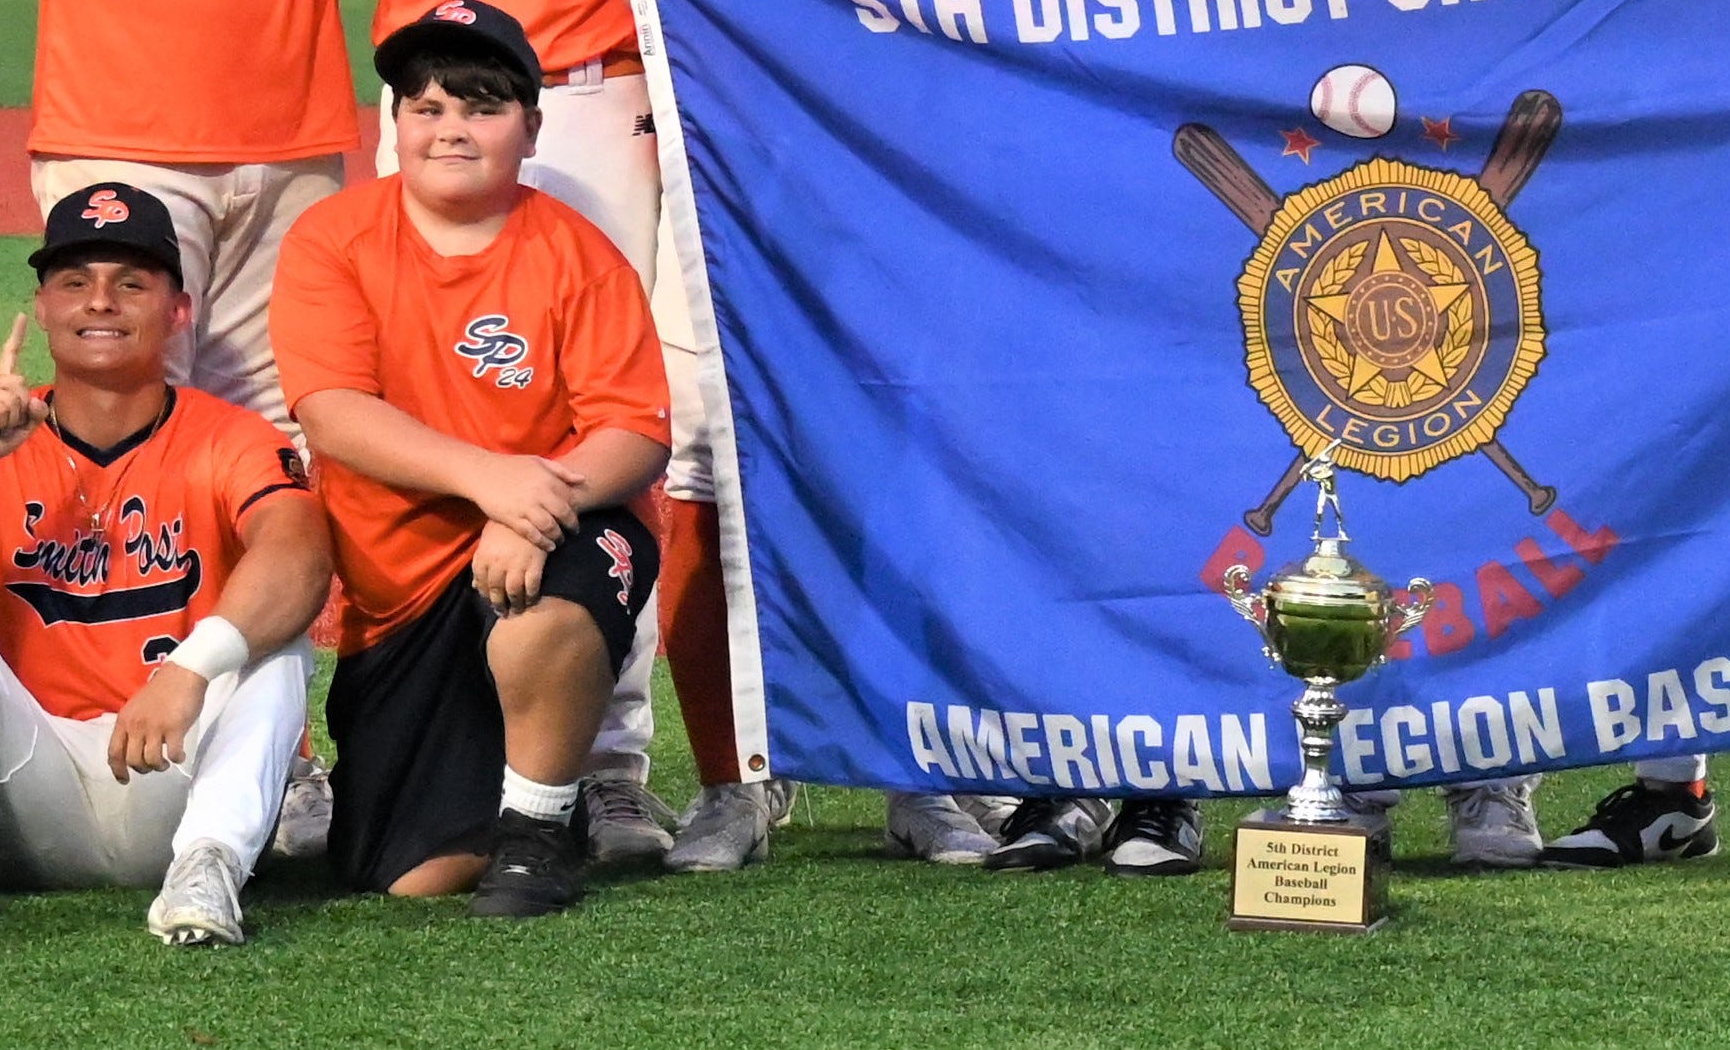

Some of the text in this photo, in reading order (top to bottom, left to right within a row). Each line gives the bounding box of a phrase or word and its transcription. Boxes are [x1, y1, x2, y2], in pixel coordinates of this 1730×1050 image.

[1274, 191, 1504, 294] AMERICAN
[496, 368, 534, 389] 24
[1315, 389, 1484, 449] LEGION
[1200, 507, 1620, 660] BBALL
[905, 698, 1273, 792] AMERICAN
[1297, 685, 1567, 788] EGION
[1266, 841, 1339, 858] 5th District
[1247, 857, 1357, 877] American Legion
[1275, 875, 1328, 890] Baseball
[1264, 890, 1337, 908] Champions
